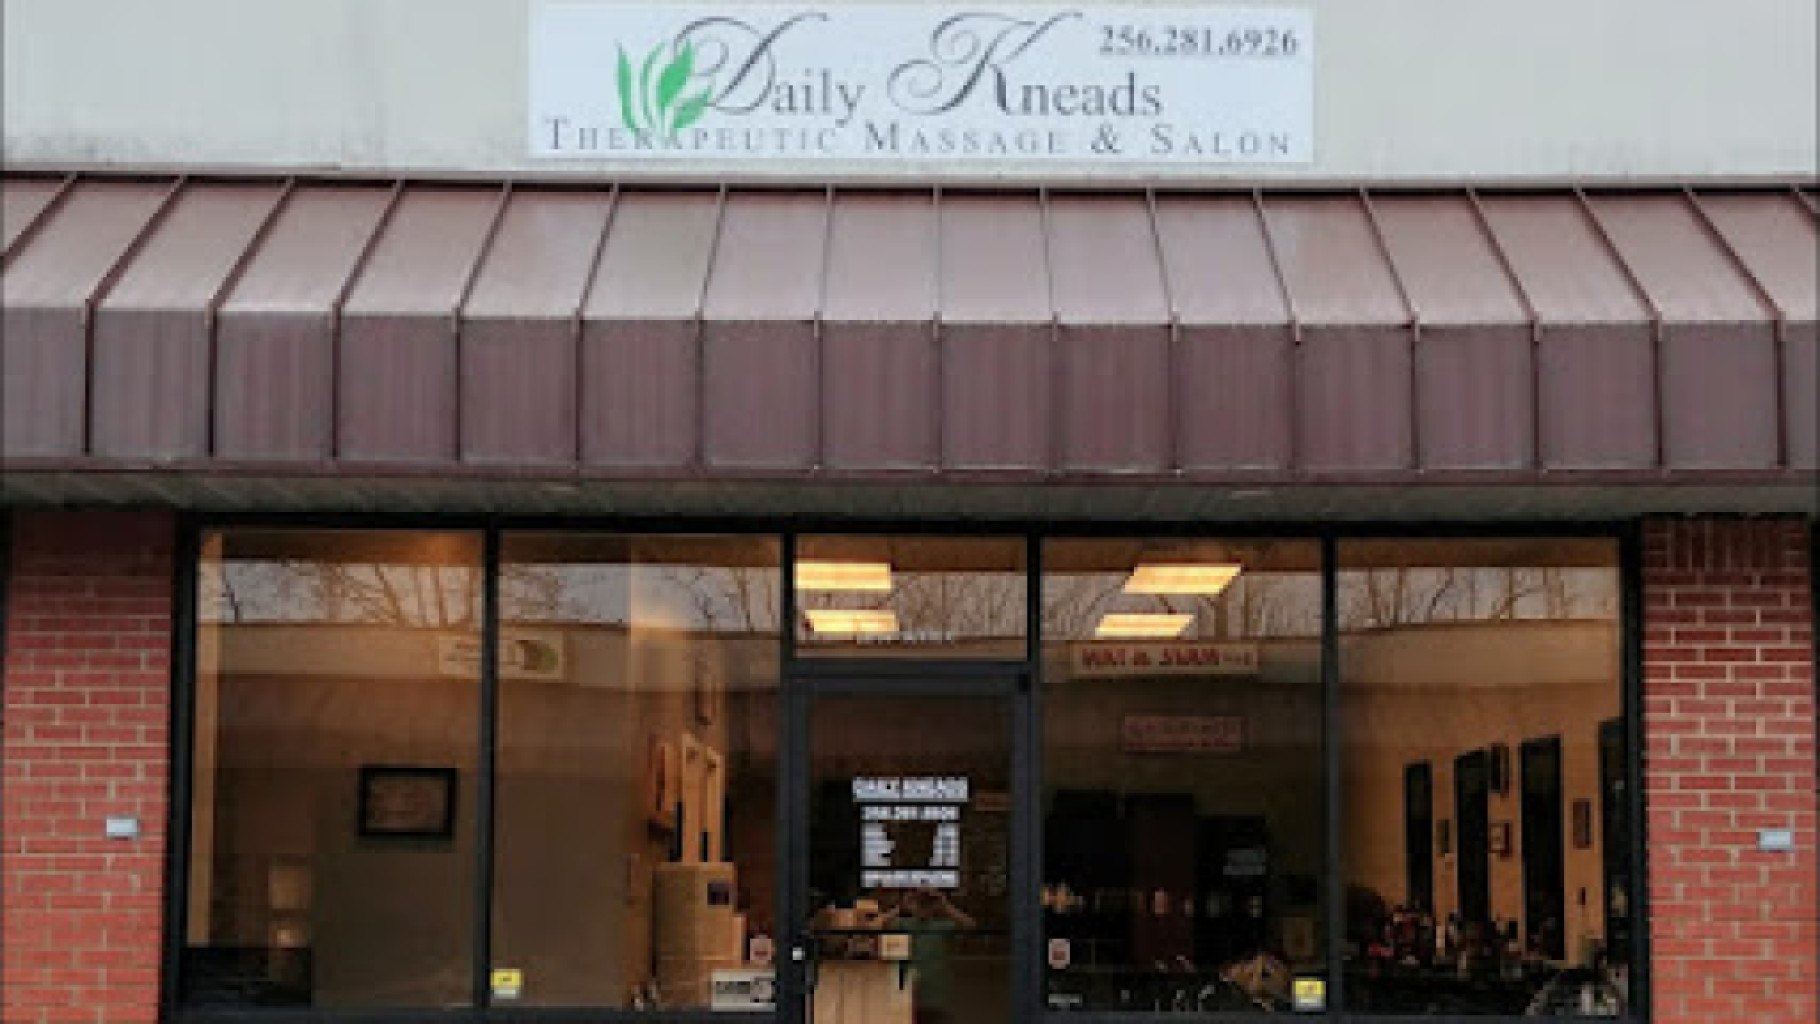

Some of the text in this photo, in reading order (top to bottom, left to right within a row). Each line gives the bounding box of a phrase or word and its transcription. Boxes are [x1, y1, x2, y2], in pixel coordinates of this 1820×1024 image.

[1098, 24, 1299, 56] 256.281.6926
[674, 12, 1163, 127] Daily Kneads
[865, 121, 1067, 153] MASSAGE
[1091, 123, 1122, 155] &
[1150, 123, 1291, 155] SALON
